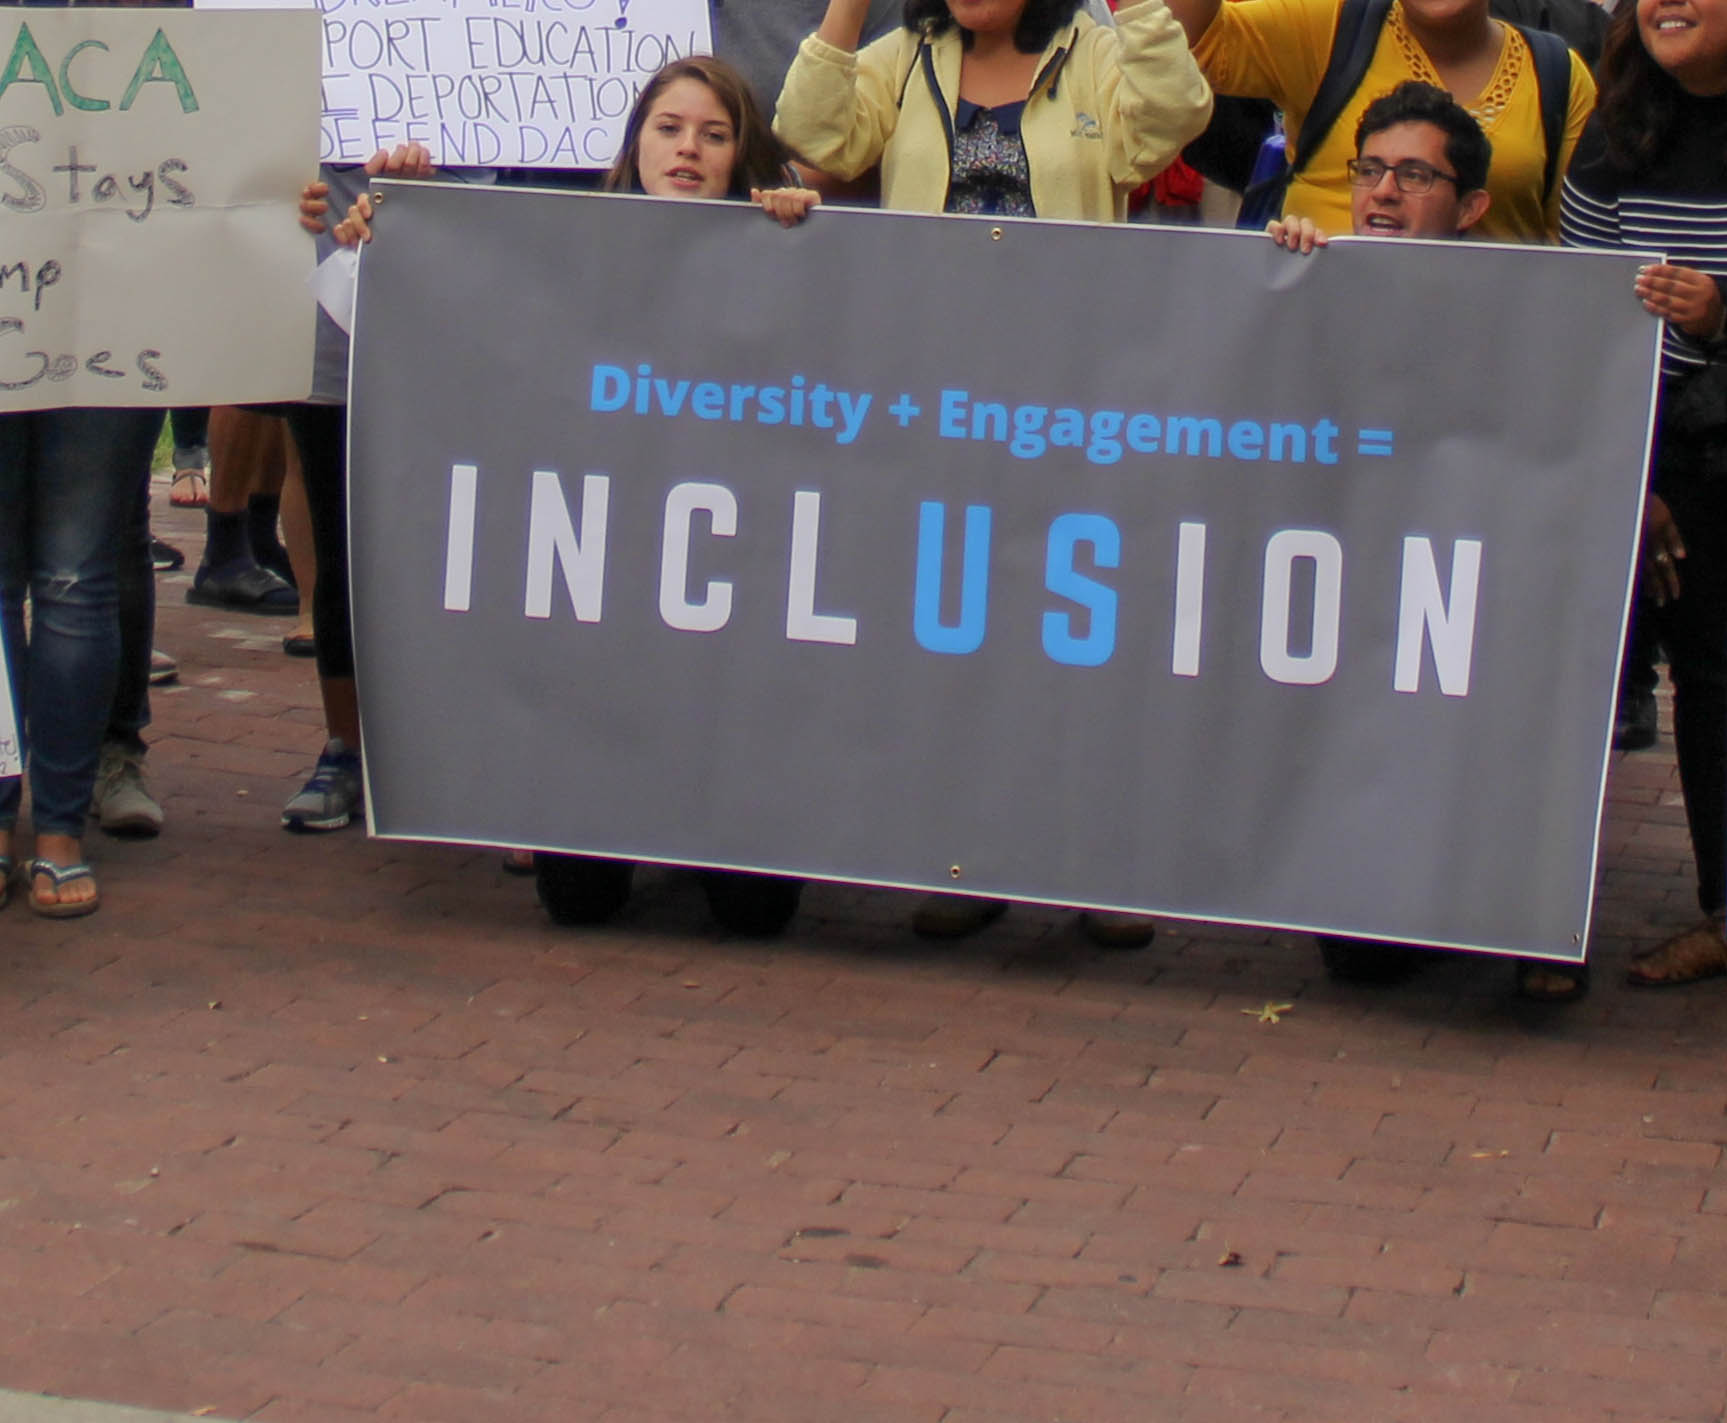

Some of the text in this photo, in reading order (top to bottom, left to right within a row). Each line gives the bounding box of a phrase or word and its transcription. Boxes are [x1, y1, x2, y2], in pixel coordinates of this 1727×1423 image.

[323, 16, 696, 74] PORT EDUCATION
[520, 126, 614, 164] DAC
[590, 365, 872, 444] Diversity
[938, 389, 1340, 465] Engagement
[443, 464, 1483, 698] INCLUSION
